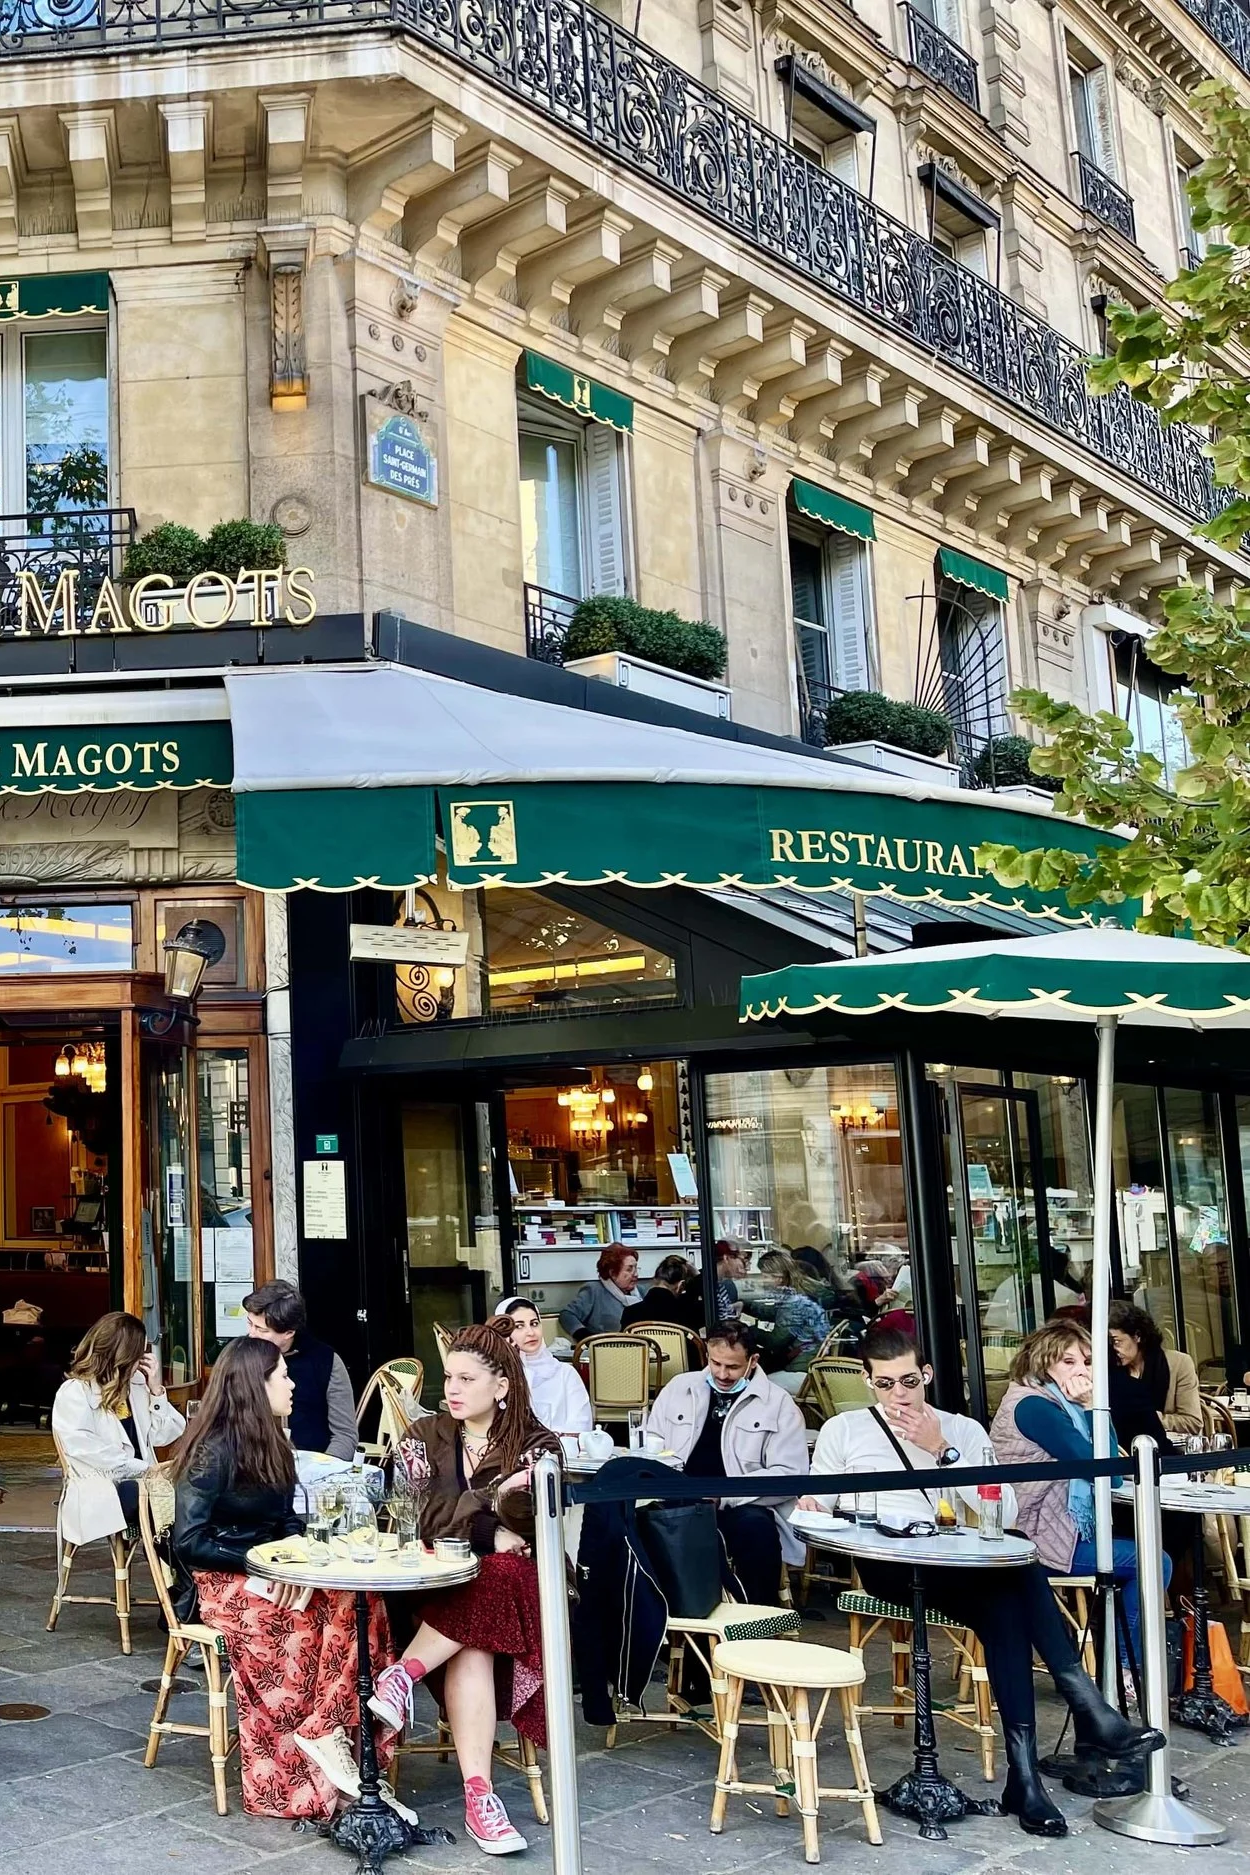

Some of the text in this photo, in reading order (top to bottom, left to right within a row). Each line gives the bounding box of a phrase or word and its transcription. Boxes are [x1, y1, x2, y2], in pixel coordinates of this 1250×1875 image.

[395, 445, 414, 460] PLACE
[383, 453, 427, 478] SAINT-GERMAIN
[390, 469, 420, 489] DES PRÉS
[14, 565, 318, 637] MAGOTS
[11, 741, 180, 778] MAGOTS
